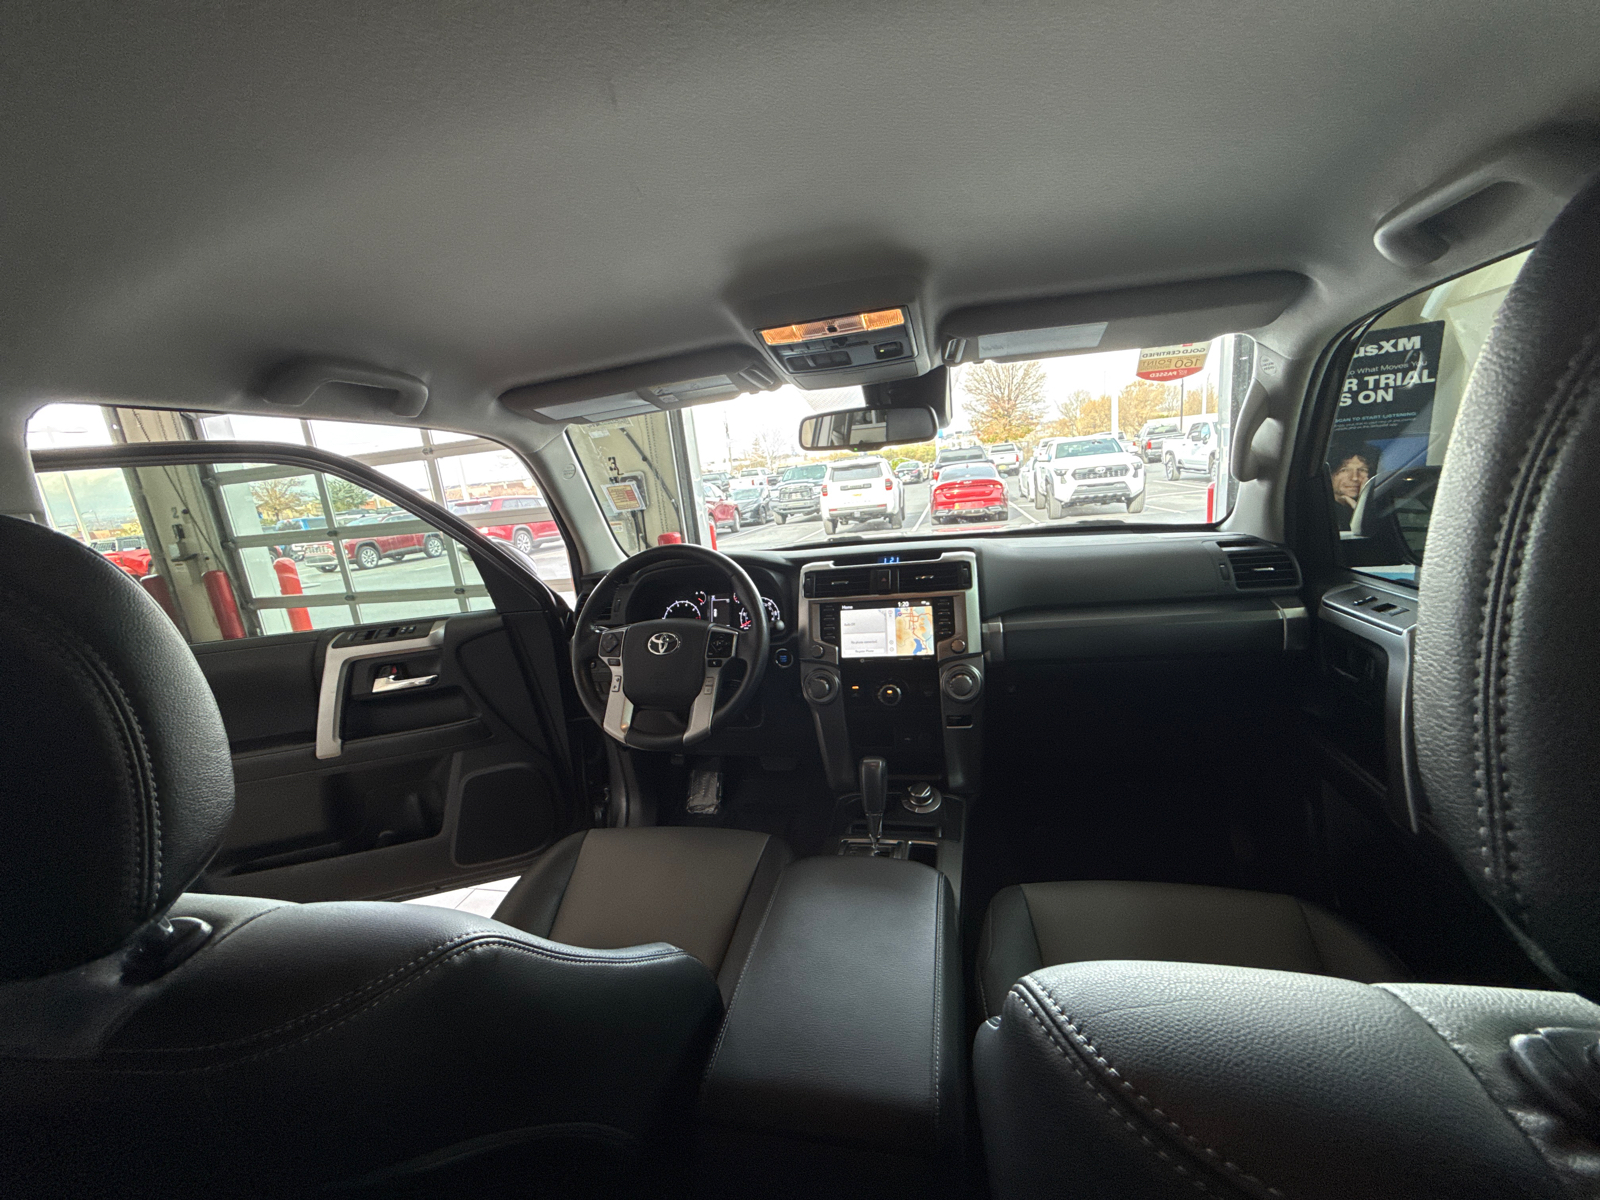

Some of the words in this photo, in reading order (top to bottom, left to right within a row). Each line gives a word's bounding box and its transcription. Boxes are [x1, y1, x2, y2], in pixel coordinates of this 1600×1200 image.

[1353, 335, 1421, 359] usXM
[1357, 365, 1379, 374] What
[1380, 363, 1409, 371] Moves
[1343, 378, 1358, 392] R
[1364, 369, 1436, 389] TRIAL
[1339, 393, 1353, 407] S
[1358, 388, 1394, 404] ON
[171, 506, 179, 519] 2
